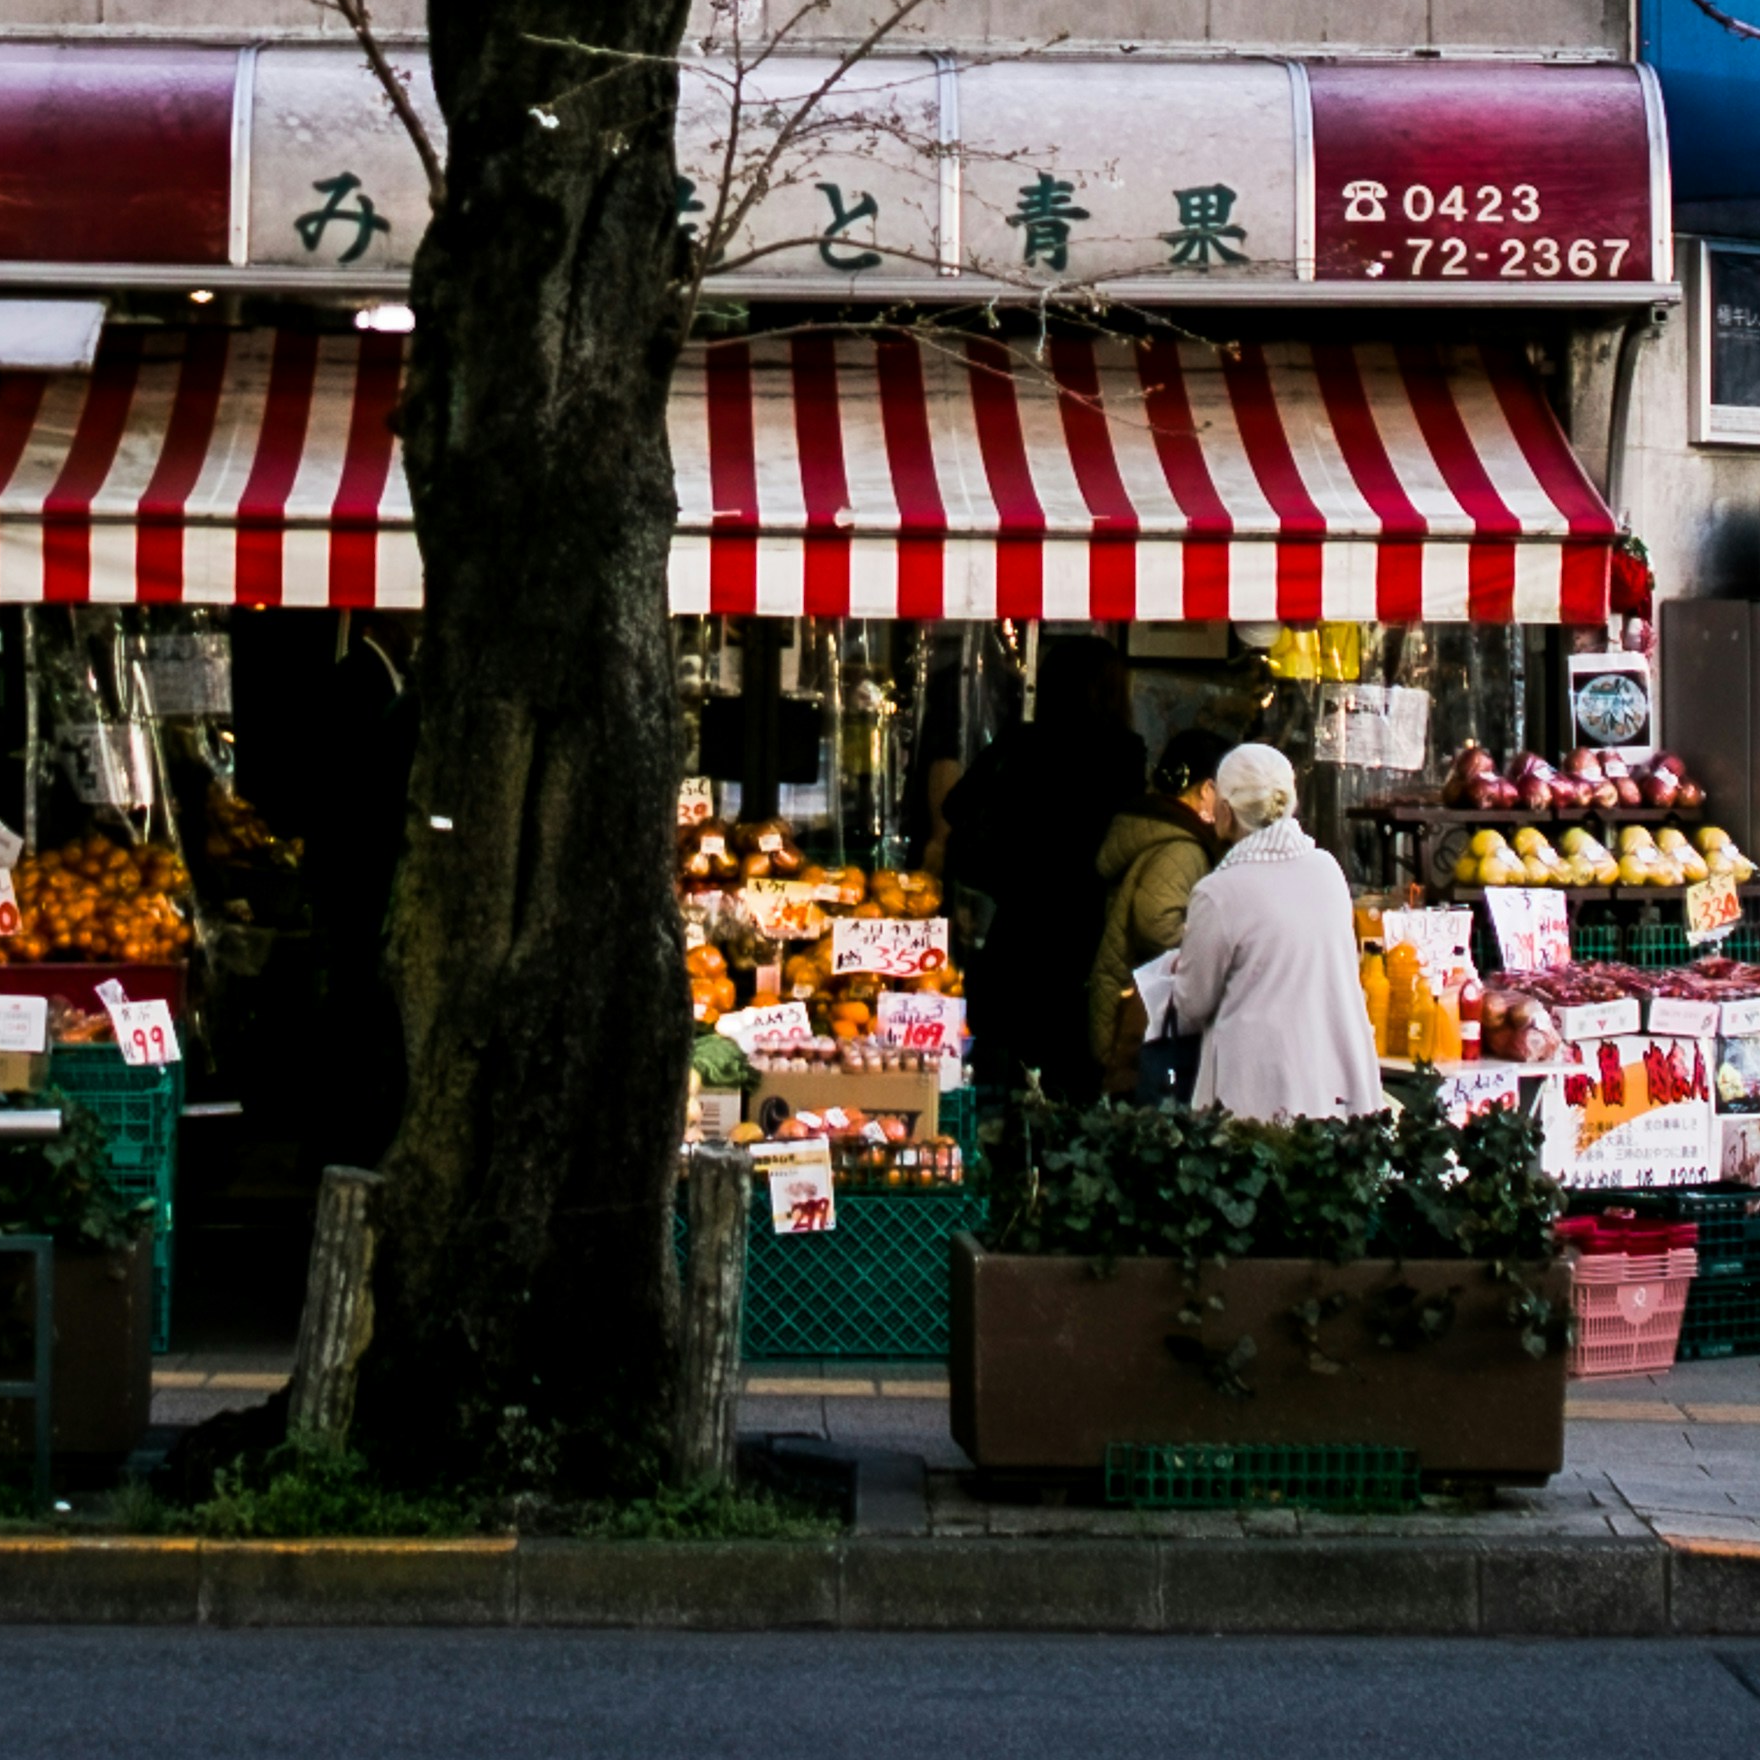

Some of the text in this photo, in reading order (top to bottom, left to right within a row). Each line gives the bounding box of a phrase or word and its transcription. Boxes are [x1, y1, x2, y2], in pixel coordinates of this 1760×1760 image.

[1402, 184, 1542, 224] 0423
[873, 946, 946, 976] 350
[132, 1025, 167, 1064] 99
